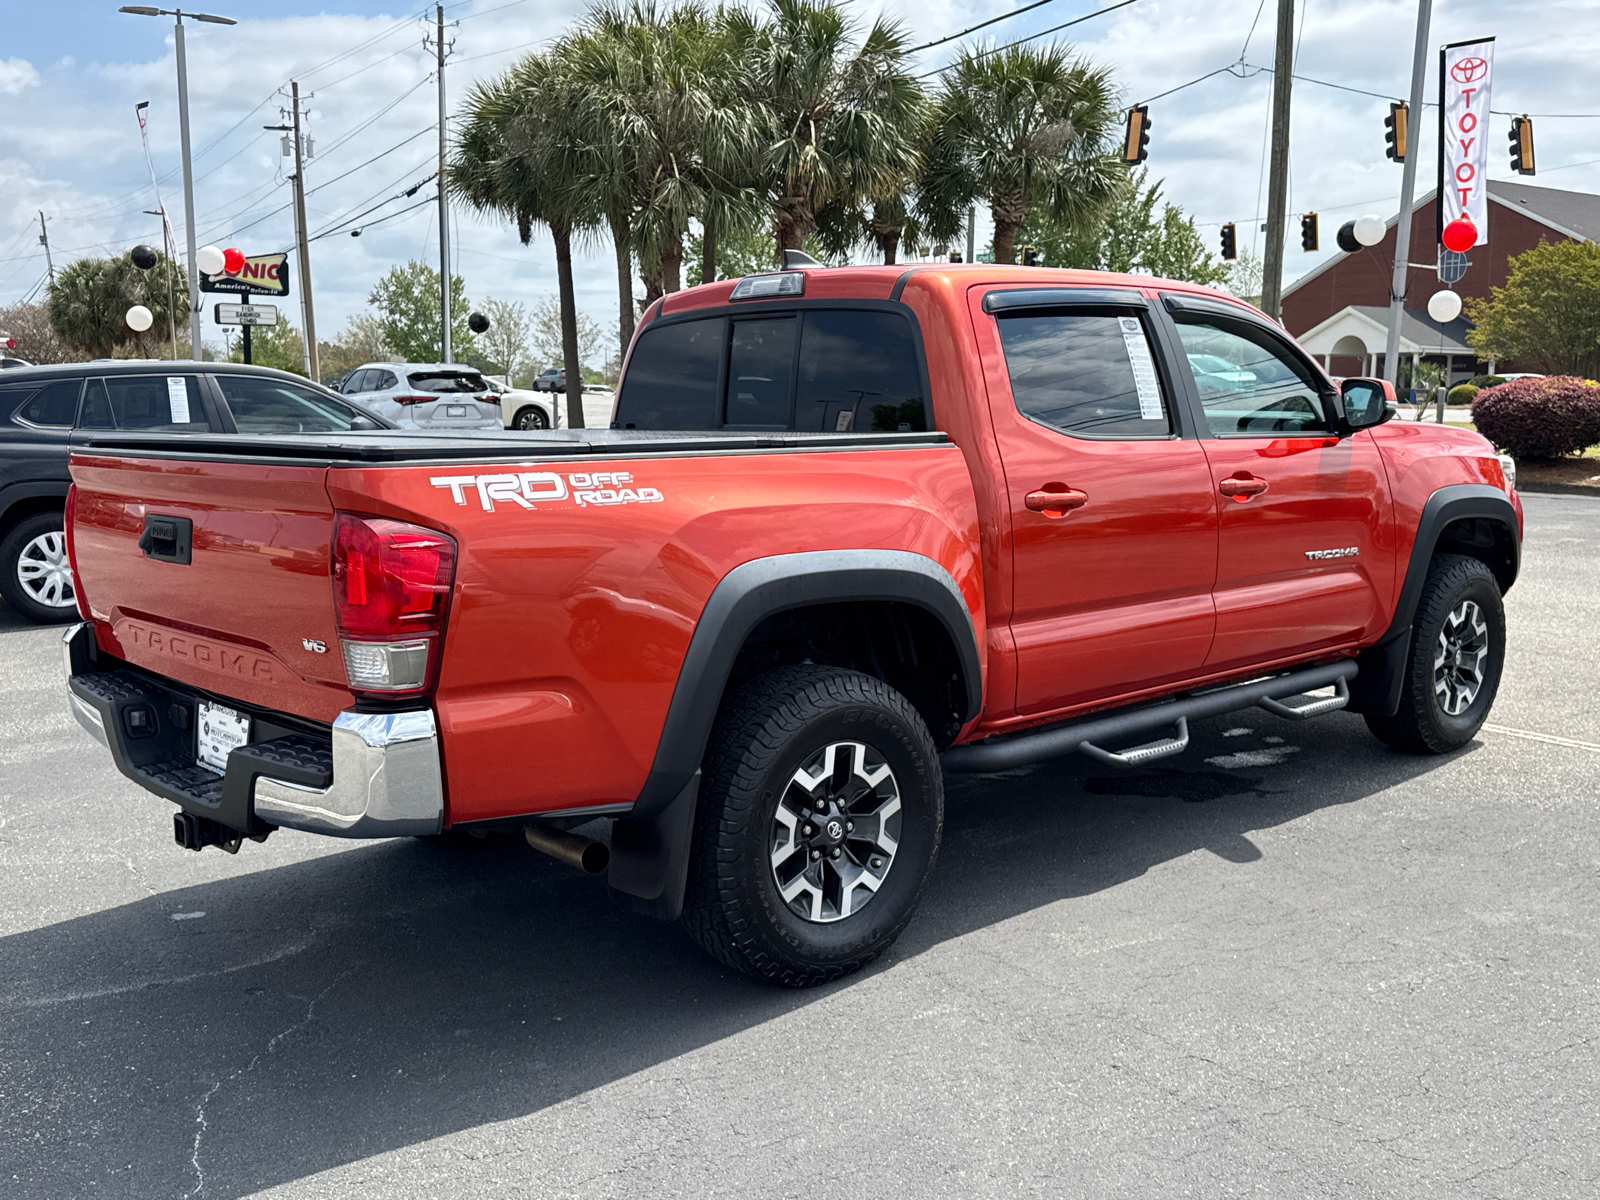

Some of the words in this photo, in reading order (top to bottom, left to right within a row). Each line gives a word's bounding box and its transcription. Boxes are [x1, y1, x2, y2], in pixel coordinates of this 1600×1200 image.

[214, 283, 250, 291] America's
[568, 472, 634, 489] OFF
[430, 472, 569, 512] TRD
[573, 487, 664, 508] ROAD
[1305, 546, 1360, 560] TACOMA
[128, 624, 275, 683] TACOMA
[302, 638, 328, 654] V6
